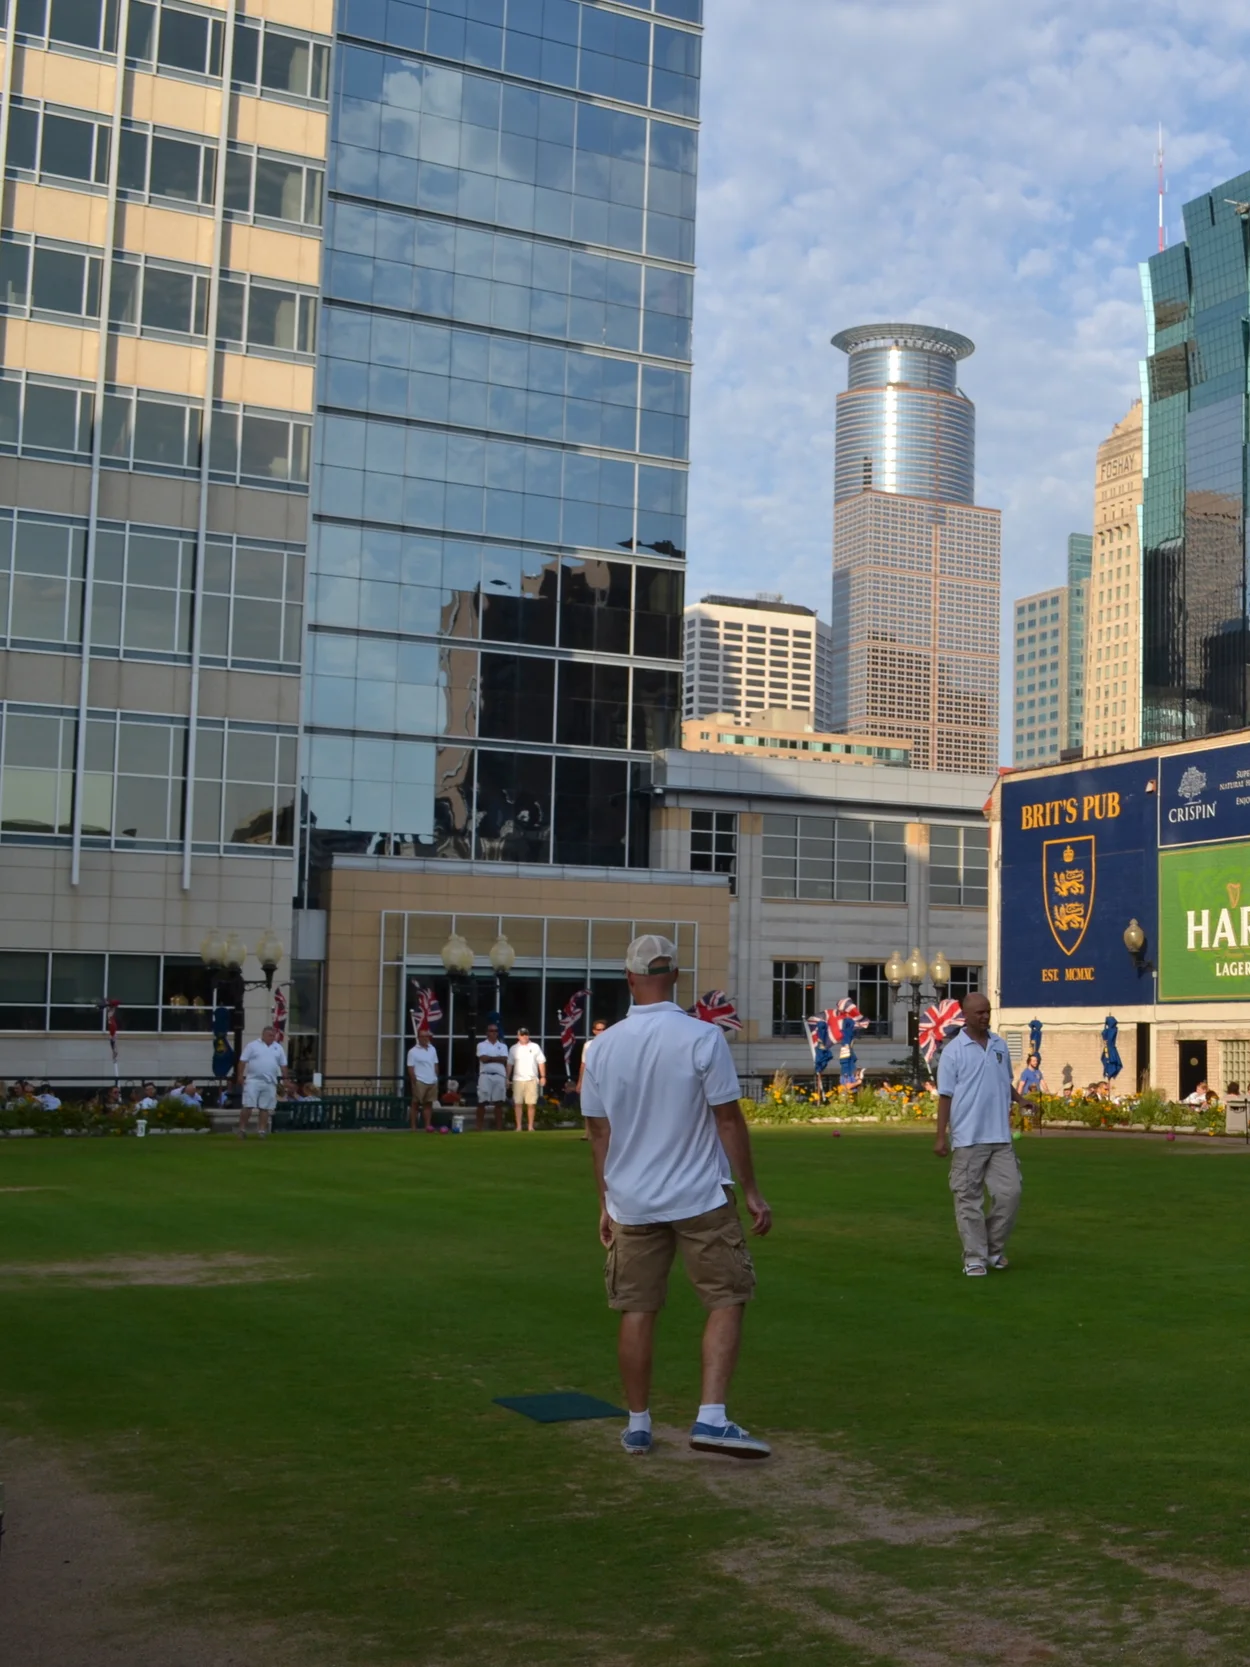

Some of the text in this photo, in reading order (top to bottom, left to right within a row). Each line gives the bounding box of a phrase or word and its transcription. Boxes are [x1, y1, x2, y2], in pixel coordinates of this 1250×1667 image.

[1219, 780, 1244, 791] NATURAL
[1021, 792, 1121, 830] BRIT'S PUB
[1065, 967, 1095, 981] MCMXC
